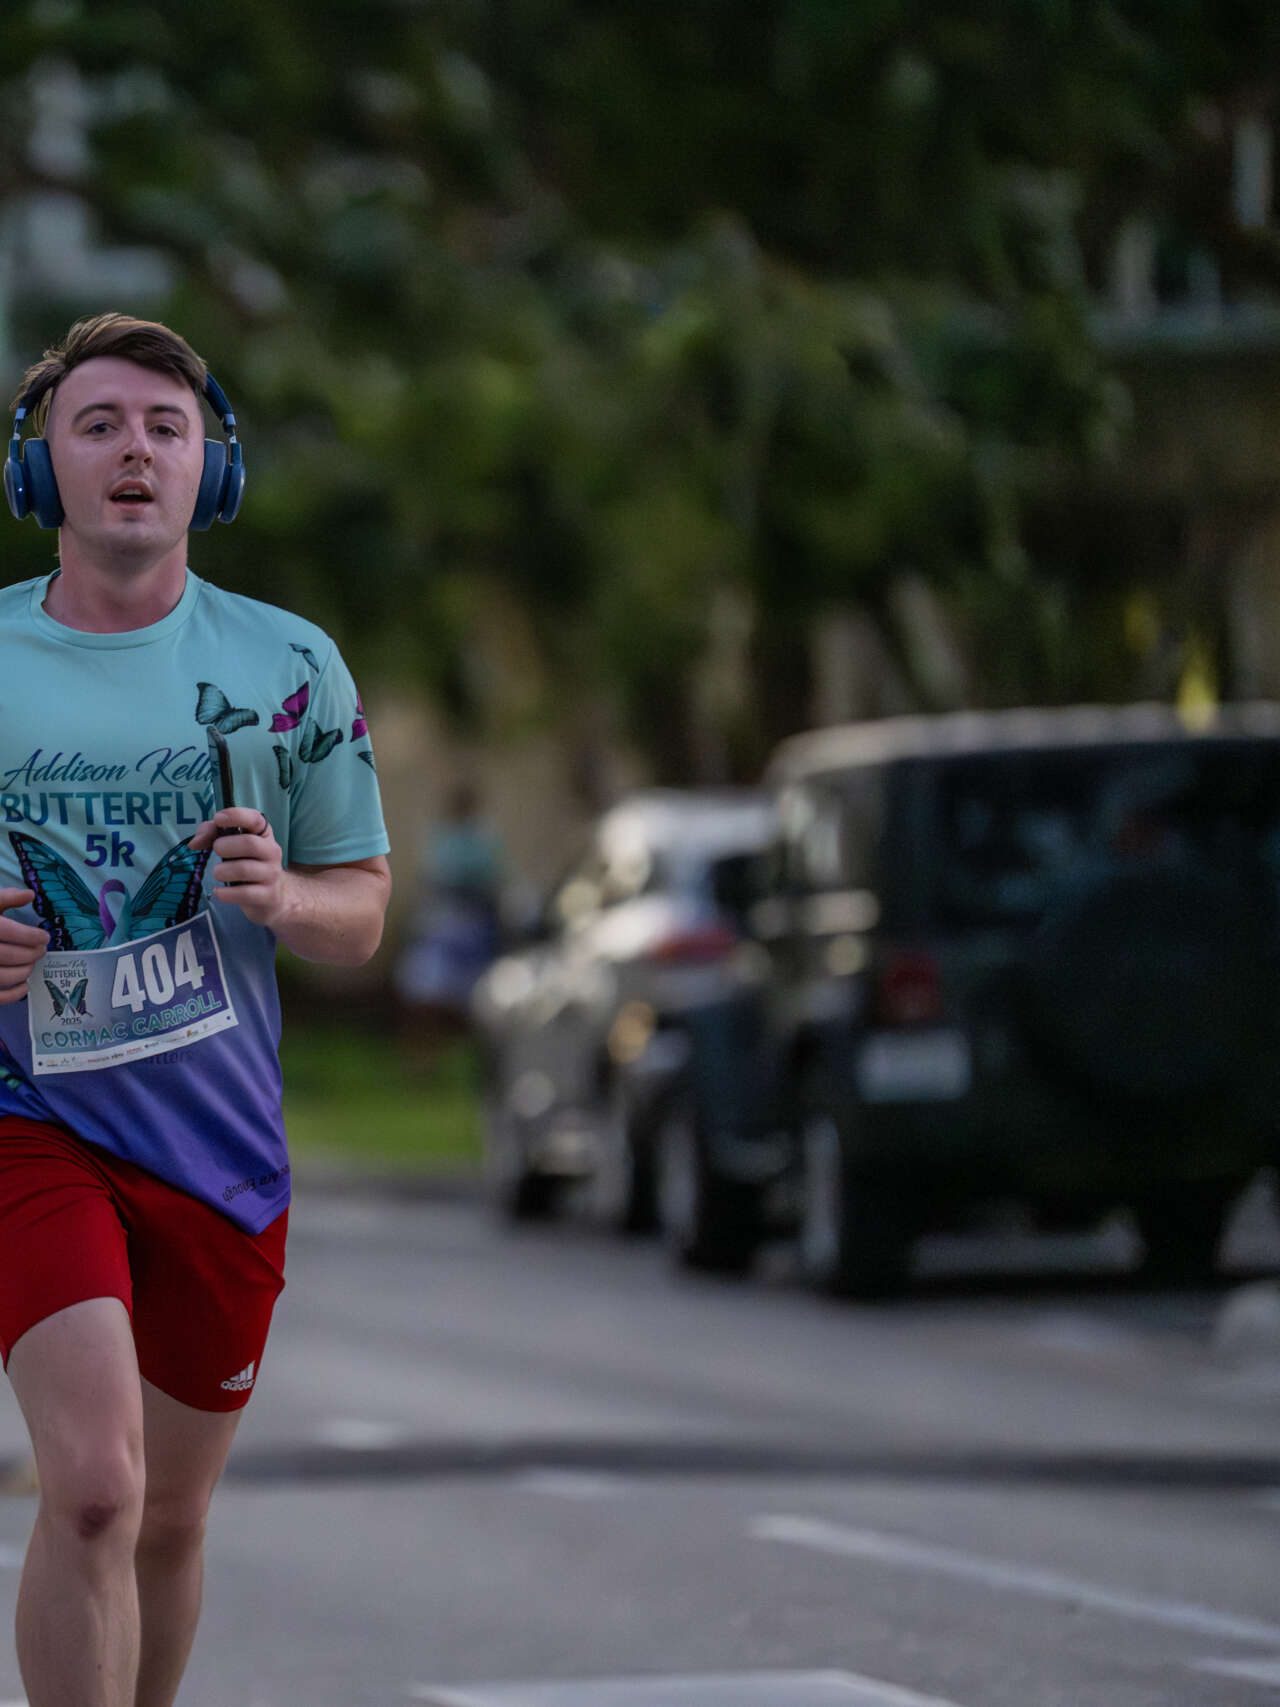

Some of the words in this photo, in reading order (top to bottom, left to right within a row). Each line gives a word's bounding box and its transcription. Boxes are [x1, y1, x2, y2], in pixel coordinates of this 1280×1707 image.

[0, 748, 131, 790] Addison
[0, 792, 215, 825] BUTTERFLY
[111, 930, 205, 1013] 404
[41, 1022, 129, 1049] CORMAC
[134, 991, 222, 1036] CARROLL
